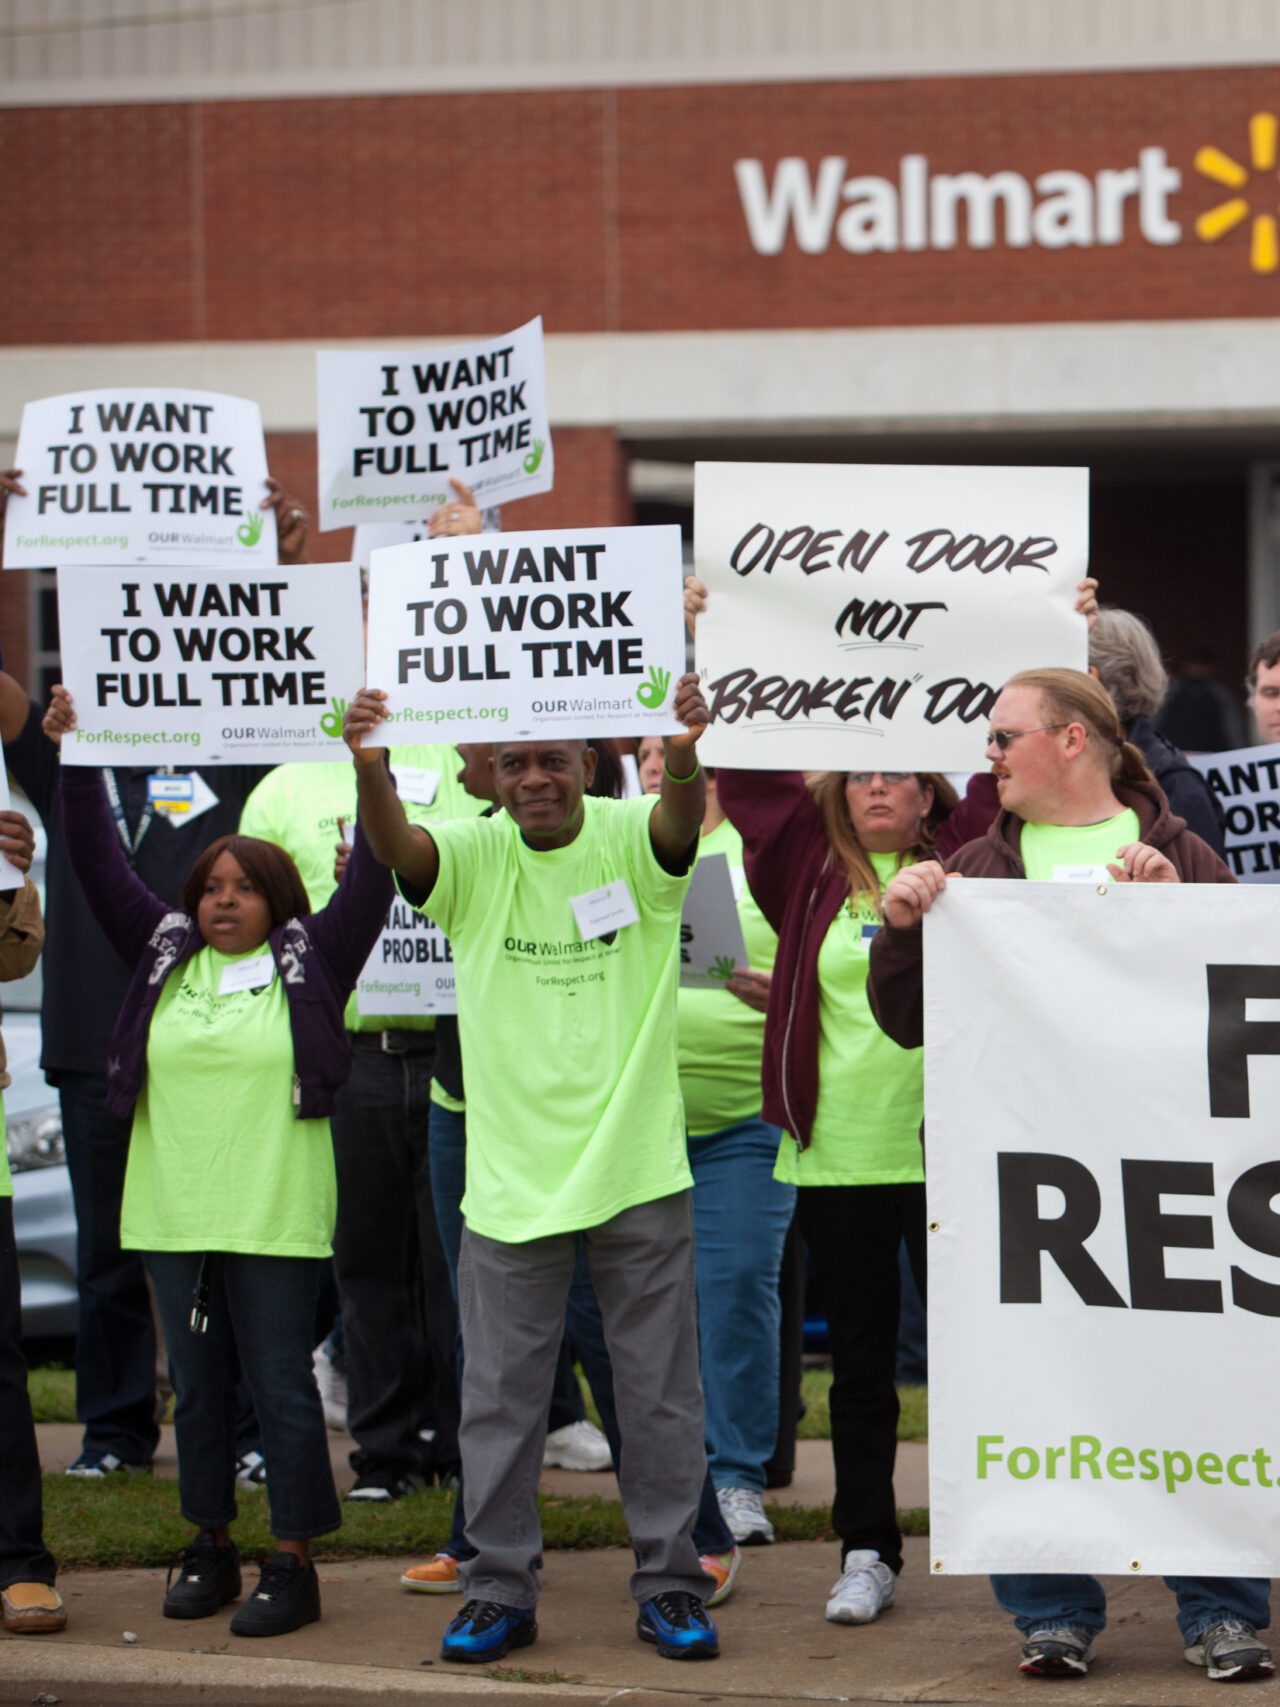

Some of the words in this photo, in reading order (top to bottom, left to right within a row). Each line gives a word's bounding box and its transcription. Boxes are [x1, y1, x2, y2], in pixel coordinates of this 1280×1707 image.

[734, 146, 1181, 254] Walmart
[381, 365, 399, 396] I
[412, 346, 514, 394] WANT
[68, 405, 85, 434] I
[97, 402, 214, 434] WANT
[359, 405, 415, 437] TO
[428, 379, 527, 433] WORK
[47, 443, 97, 475] TO
[110, 442, 235, 475] WORK
[353, 443, 449, 477] FULL
[458, 419, 531, 467] TIME
[37, 483, 132, 515] FULL
[143, 483, 243, 516] TIME
[331, 491, 447, 510] ForRespect.org
[16, 533, 129, 549] ForRespect.org
[729, 522, 889, 577] OPEN
[905, 528, 1058, 575] DOOR
[430, 553, 449, 589] I
[464, 544, 606, 586] WANT
[121, 583, 141, 617] I
[153, 582, 288, 617] WANT
[406, 598, 468, 636] TO
[481, 591, 633, 632] WORK
[834, 597, 949, 642] NOT
[100, 627, 160, 662] TO
[173, 626, 316, 662] WORK
[398, 644, 510, 684] FULL
[521, 638, 644, 678] TIME
[96, 672, 202, 707] FULL
[211, 671, 327, 706] TIME
[924, 677, 1003, 724] DO
[384, 704, 509, 724] orRespect.org
[76, 729, 201, 747] ForRespect.org
[382, 937, 453, 963] PROBLE
[536, 970, 606, 987] ForRespect.org
